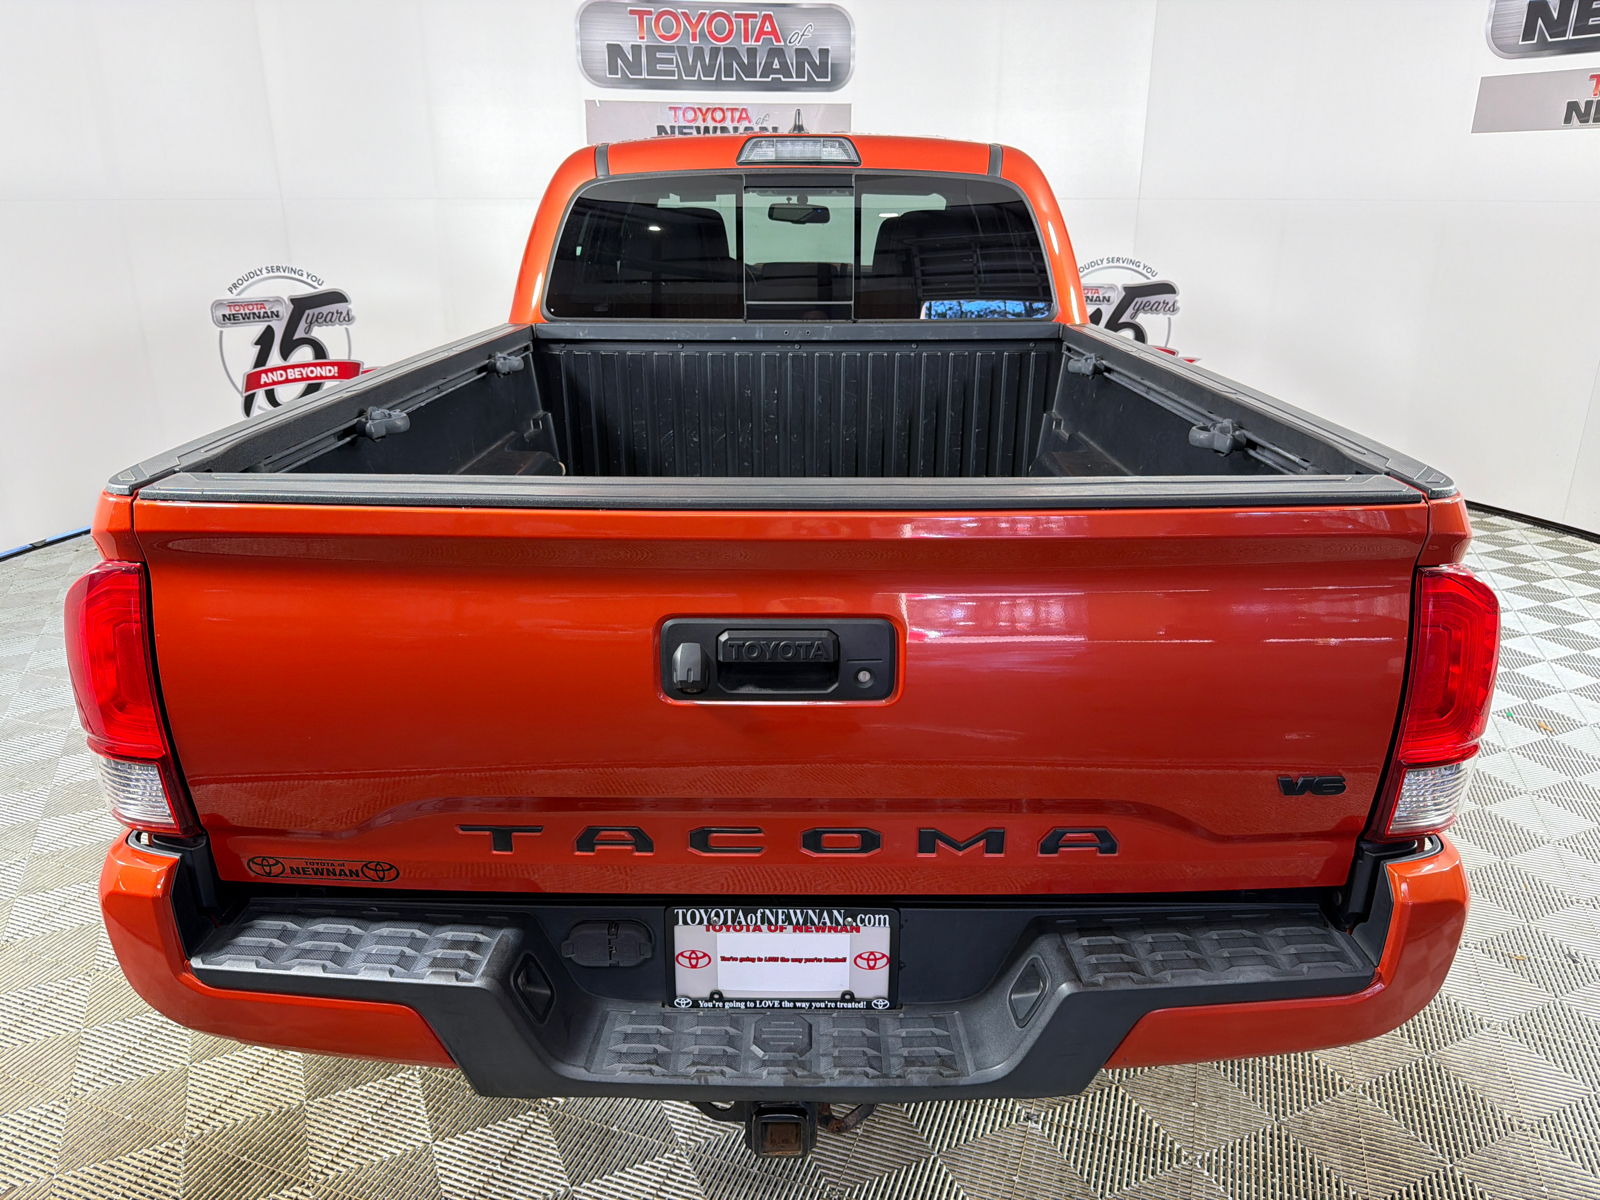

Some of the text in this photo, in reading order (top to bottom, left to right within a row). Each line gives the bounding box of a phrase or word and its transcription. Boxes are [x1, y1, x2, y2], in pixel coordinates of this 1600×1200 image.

[628, 8, 814, 46] TOYOTA of
[606, 42, 831, 82] NEWNAN
[668, 106, 770, 125] TOYOTA of
[1106, 256, 1142, 268] SERVING
[1142, 263, 1158, 278] YOU
[227, 265, 325, 295] PROUDLY SERVING YOU
[227, 303, 267, 313] TOYOTA
[1084, 295, 1111, 303] NAN
[1130, 298, 1178, 320] years
[221, 310, 280, 322] NEWNAN
[303, 309, 353, 335] years
[260, 365, 339, 385] AND BEYOND!
[727, 640, 830, 661] TOYOTA
[1277, 775, 1347, 796] V6
[456, 824, 1120, 857] TACOMA
[289, 866, 360, 878] NEWNAN
[705, 925, 861, 934] TOYOTA OF NEWNAN
[698, 1000, 723, 1008] You're
[725, 1000, 745, 1009] going
[811, 1001, 835, 1010] you're
